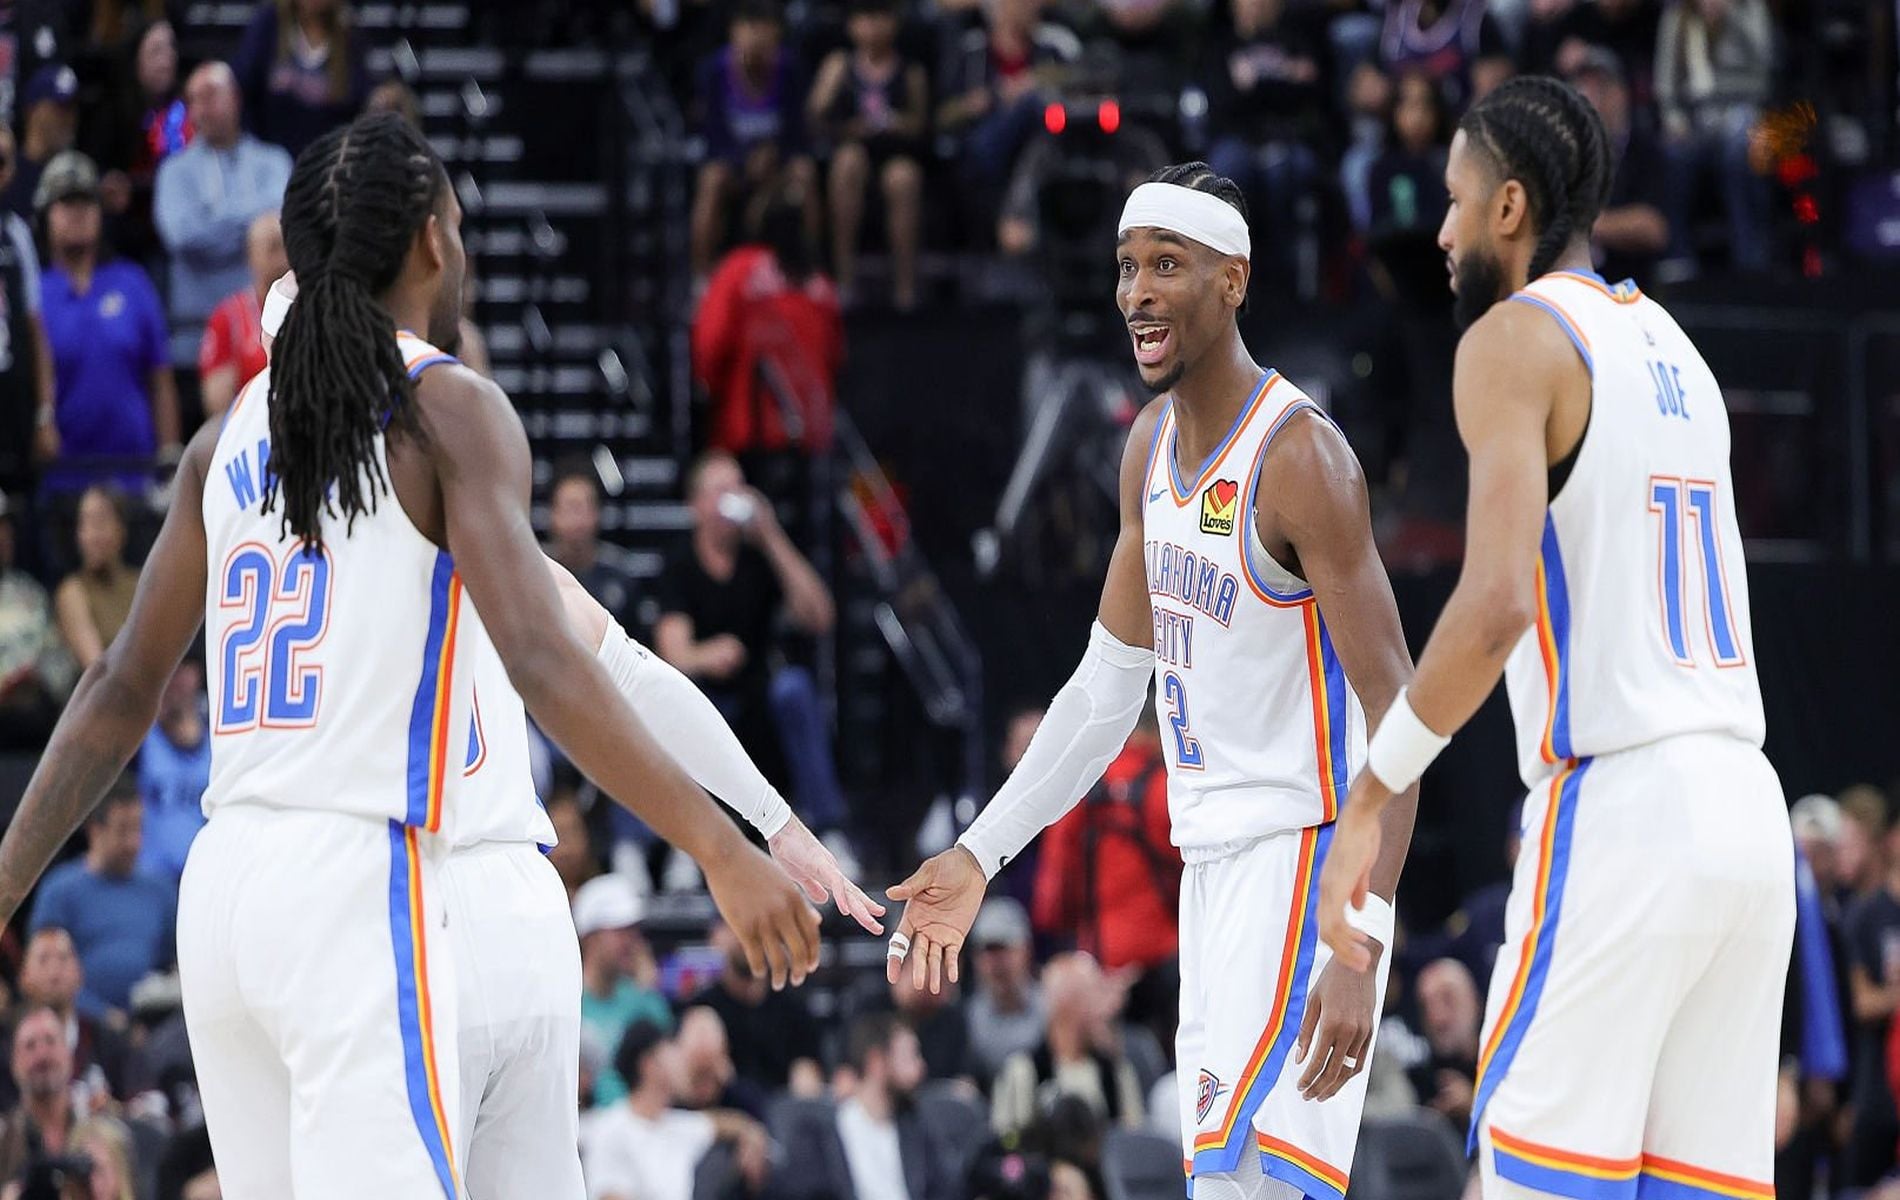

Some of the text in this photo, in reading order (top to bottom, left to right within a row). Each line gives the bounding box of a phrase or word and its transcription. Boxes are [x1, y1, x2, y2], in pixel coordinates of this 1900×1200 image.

[1646, 360, 1690, 420] JOE
[1203, 513, 1232, 530] Love's
[1648, 474, 1747, 668] 11
[215, 536, 333, 735] 22
[1153, 605, 1194, 669] CITY
[1163, 670, 1205, 770] 2
